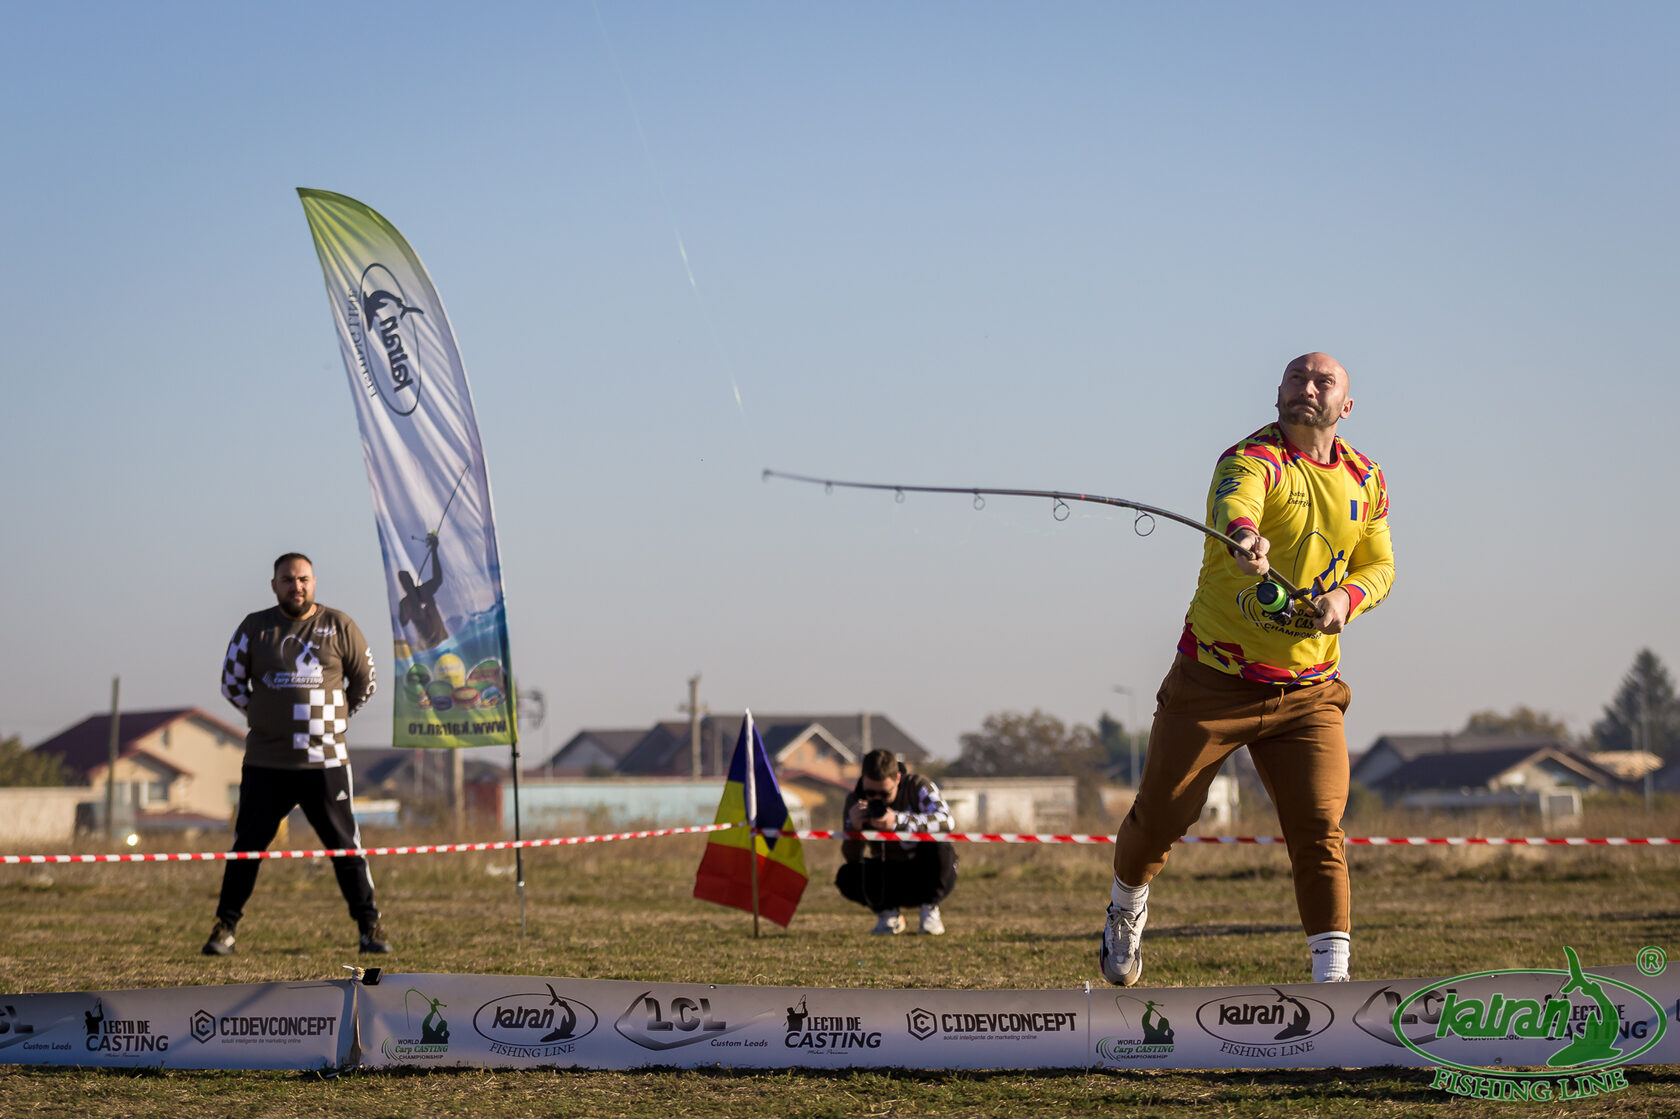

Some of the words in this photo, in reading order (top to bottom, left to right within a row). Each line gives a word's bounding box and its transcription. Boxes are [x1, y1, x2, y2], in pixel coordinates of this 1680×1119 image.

[492, 1006, 555, 1029] katran
[644, 997, 727, 1032] LCL
[1218, 1003, 1286, 1025] katran
[103, 1020, 134, 1035] LECTII
[137, 1020, 150, 1034] DE
[220, 1016, 337, 1036] CIDEVCONCEPT
[807, 1016, 844, 1031] LECTII
[846, 1016, 861, 1031] DE
[941, 1012, 1077, 1033] CIDEVCONCEPT
[23, 1041, 50, 1051] Custom
[51, 1041, 72, 1051] Leads
[86, 1036, 169, 1052] CASTING
[710, 1038, 743, 1047] Custom
[744, 1038, 769, 1048] Leads
[784, 1032, 882, 1049] CASTING
[395, 1045, 412, 1054] Carp
[414, 1044, 449, 1053] CASTING
[489, 1042, 541, 1058] FISHING
[544, 1042, 576, 1057] LINE
[1113, 1045, 1133, 1054] Carp
[1135, 1045, 1175, 1053] CASTING
[1219, 1041, 1277, 1058] FISHING
[1279, 1040, 1315, 1057] LINE
